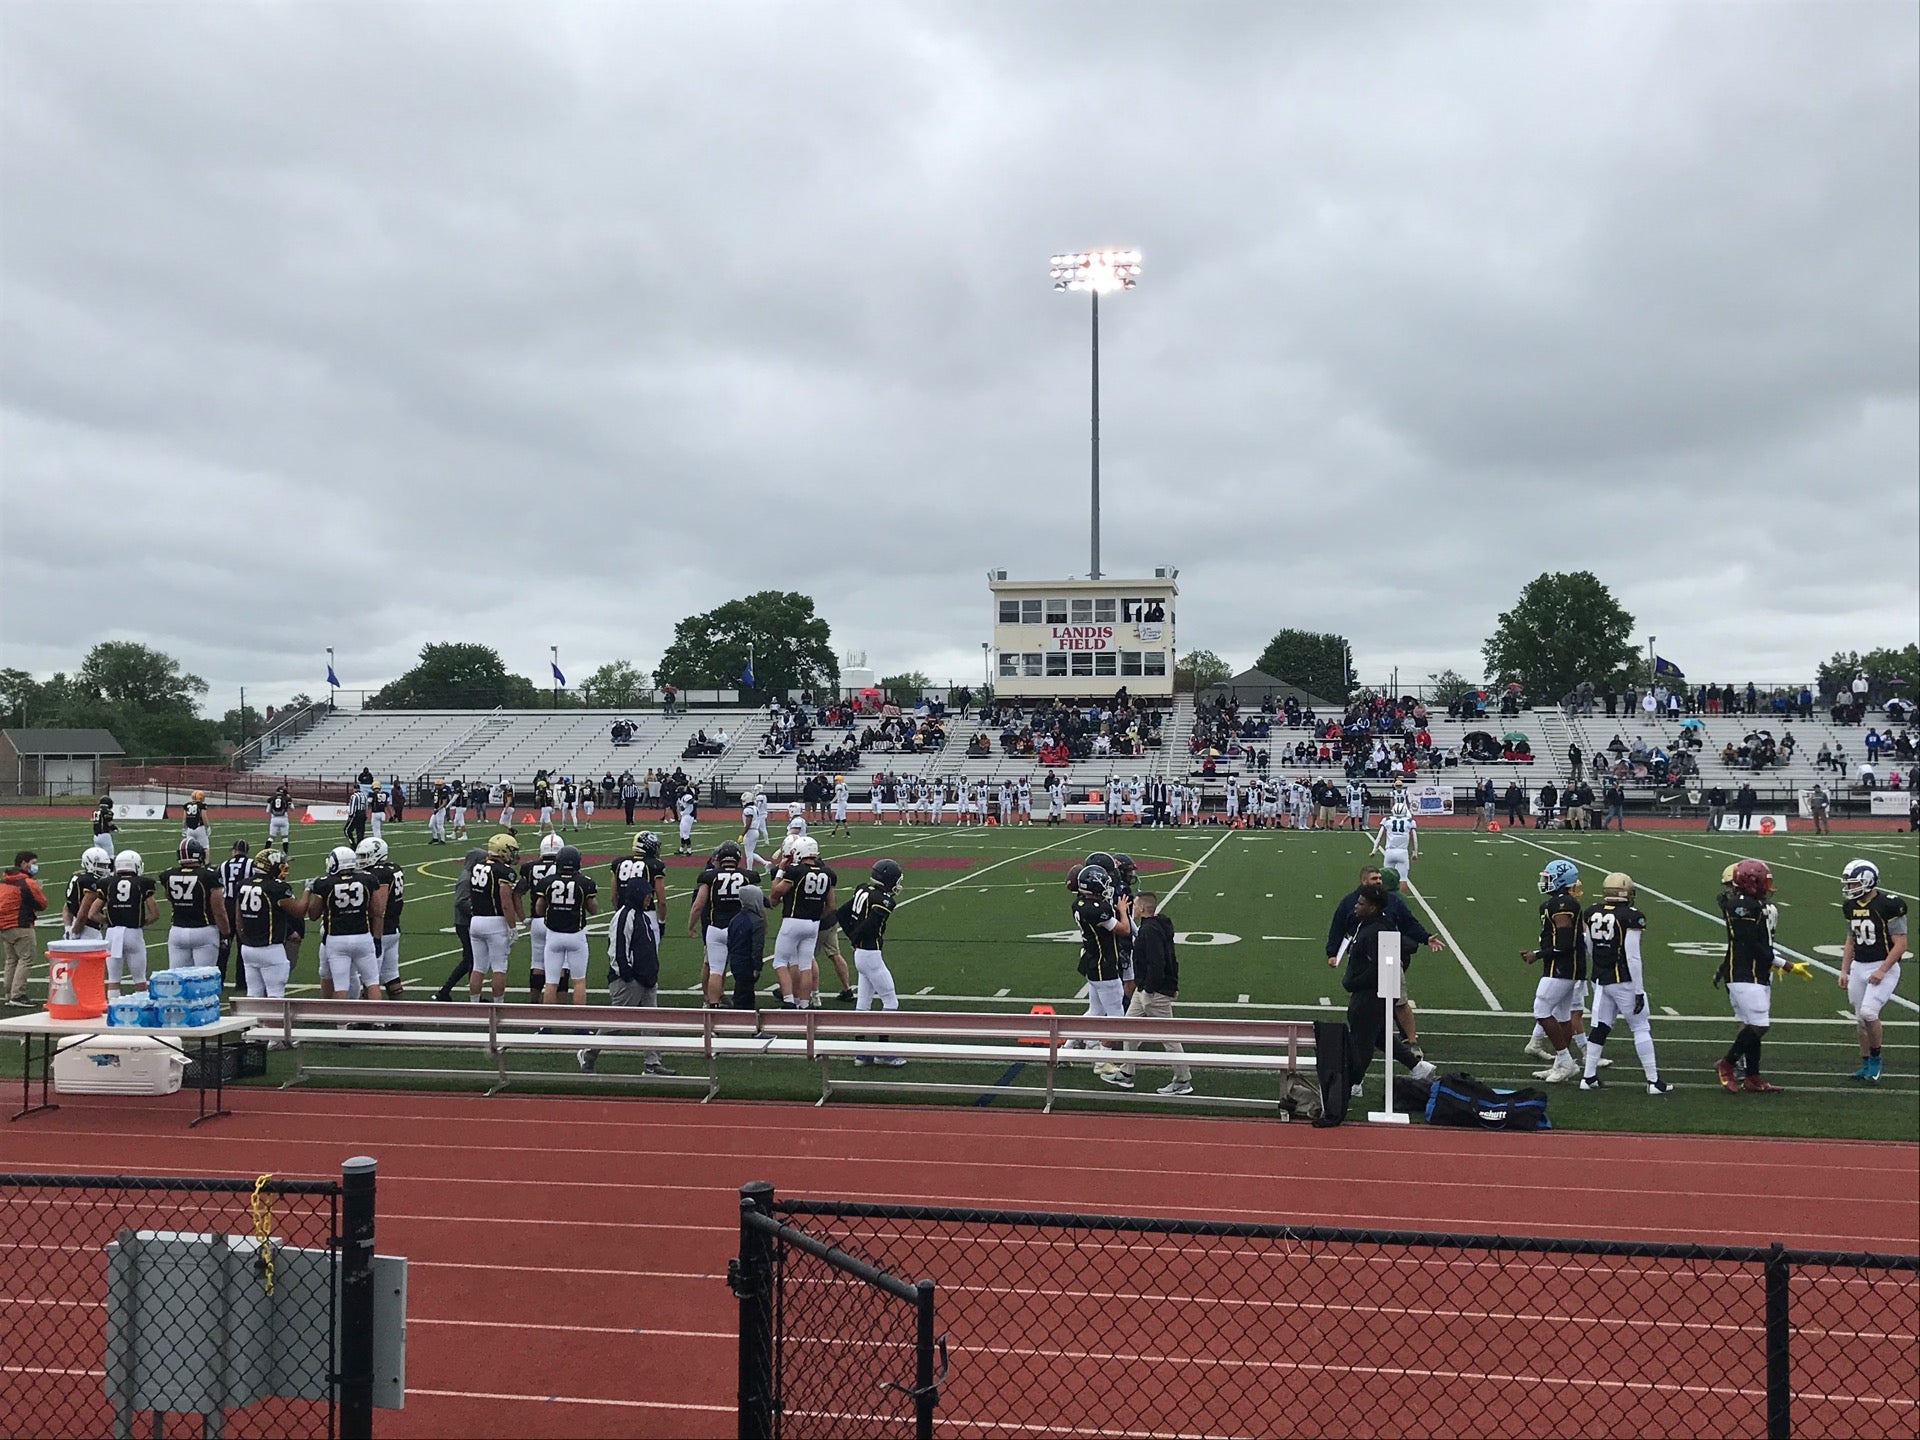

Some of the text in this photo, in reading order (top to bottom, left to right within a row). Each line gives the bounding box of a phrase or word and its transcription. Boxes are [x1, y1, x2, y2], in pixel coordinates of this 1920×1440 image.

[1053, 627, 1113, 638] LANDIS
[1059, 638, 1106, 650] FIELD
[1391, 820, 1405, 833] 11
[229, 864, 242, 881] F
[471, 864, 491, 888] 56
[619, 860, 645, 881] 88
[116, 879, 132, 902] 9
[169, 875, 198, 900] 57
[334, 881, 364, 908] 53
[551, 880, 576, 905] 21
[717, 872, 744, 895] 72
[804, 872, 828, 895] 60
[240, 885, 263, 912] 76
[852, 888, 869, 914] 10
[1591, 912, 1615, 940] 23
[1851, 919, 1876, 945] 50
[52, 962, 69, 984] G
